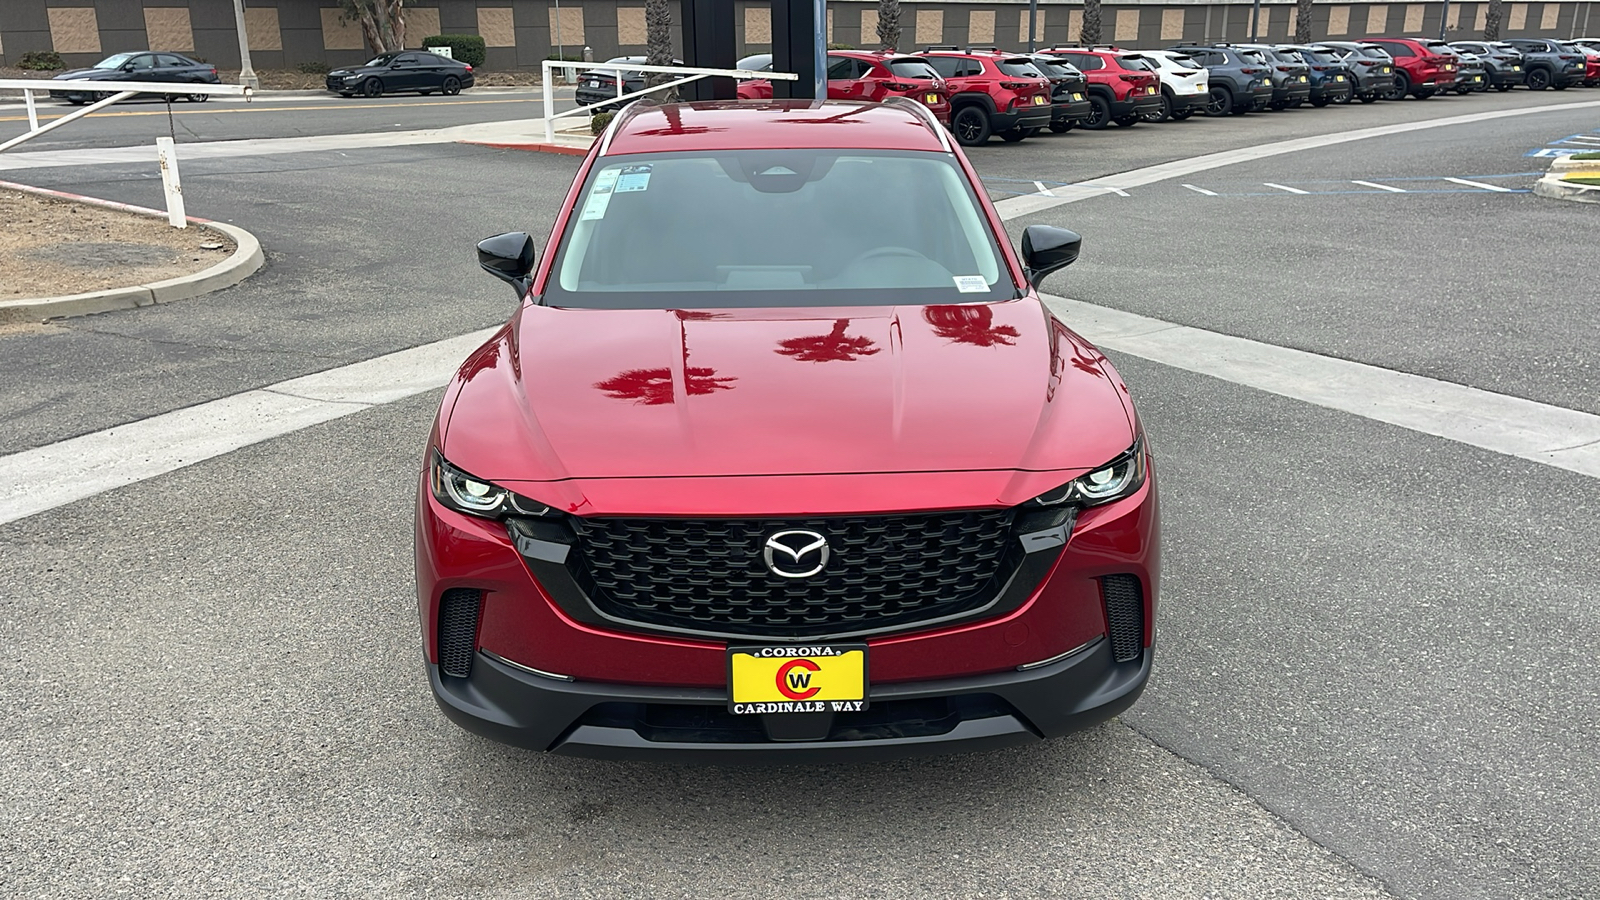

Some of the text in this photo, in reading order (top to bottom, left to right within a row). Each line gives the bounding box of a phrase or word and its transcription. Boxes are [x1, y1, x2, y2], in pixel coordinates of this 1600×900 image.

[761, 647, 834, 657] CORONA
[734, 701, 863, 714] CARDINALE WAY
